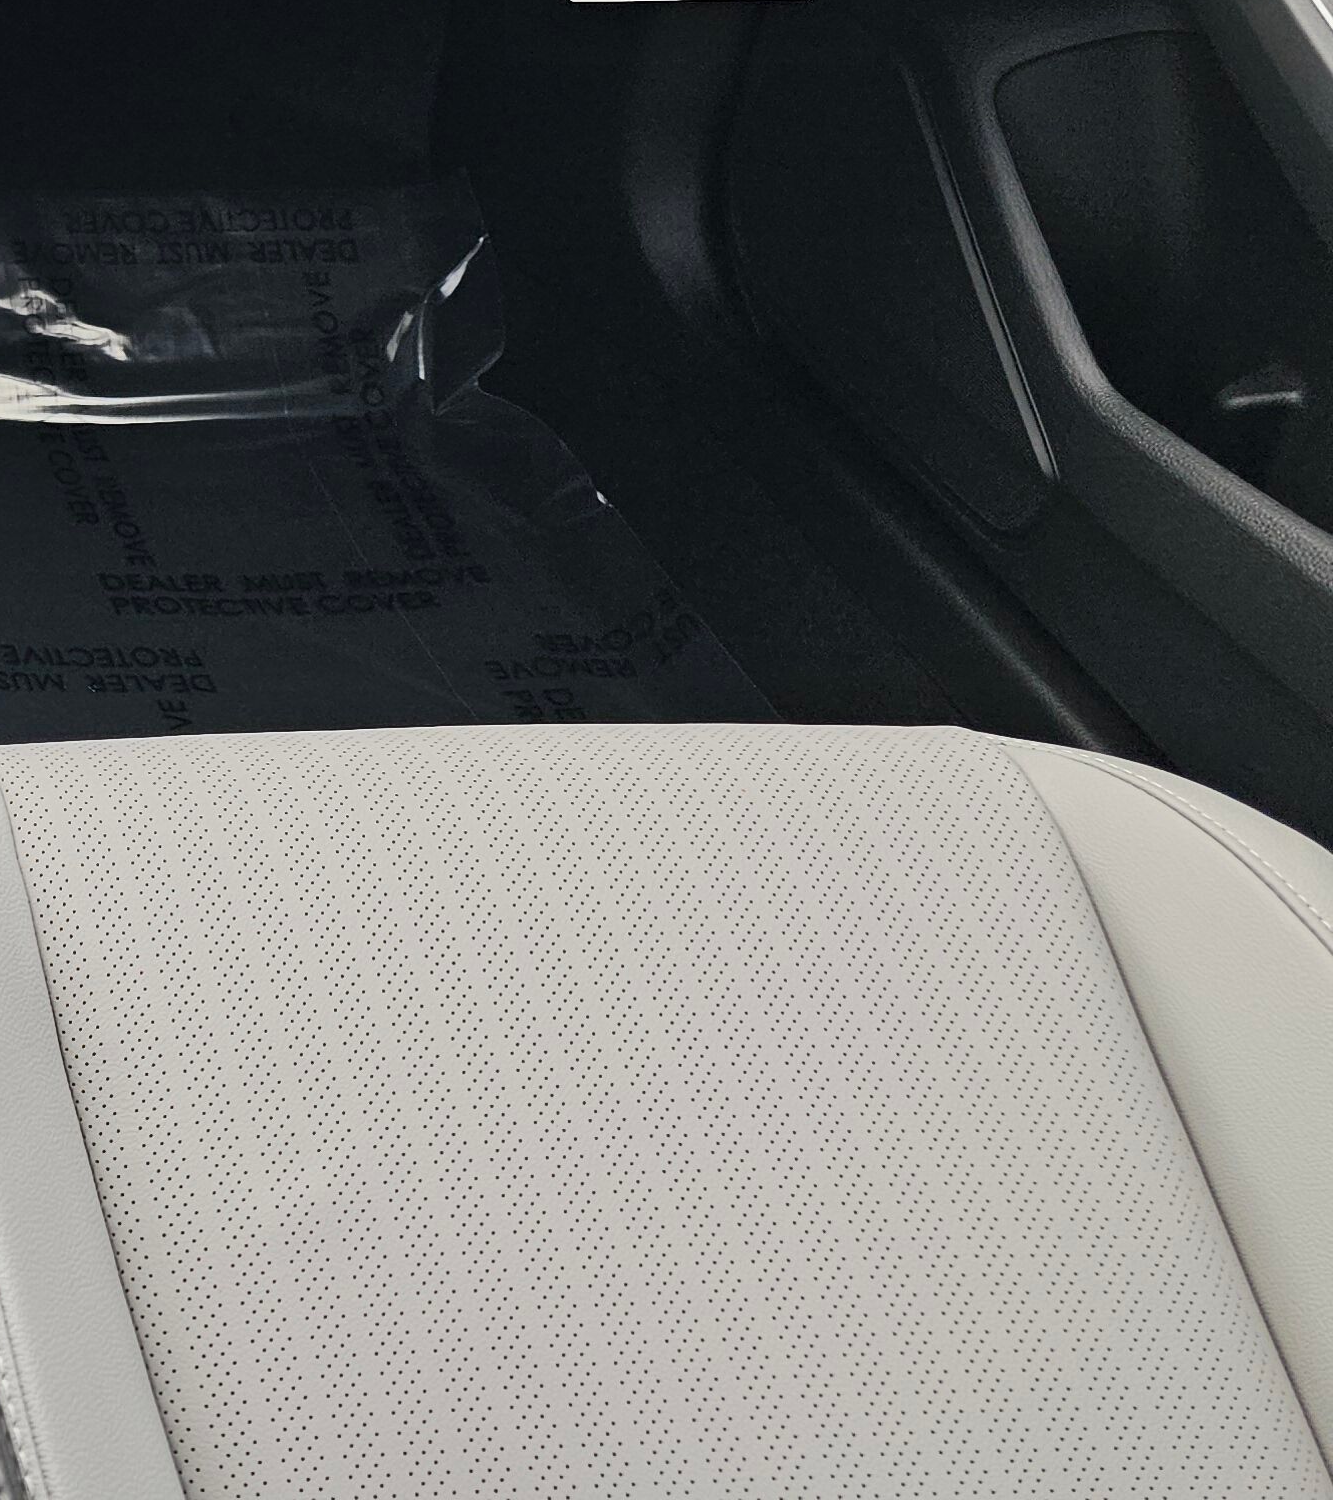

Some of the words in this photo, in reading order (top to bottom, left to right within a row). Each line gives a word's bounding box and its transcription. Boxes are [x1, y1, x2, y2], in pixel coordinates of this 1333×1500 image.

[97, 571, 225, 593] DEALER
[238, 569, 326, 593] MUST
[342, 564, 491, 590] REMOVE
[110, 594, 311, 617] PROTECTIVE
[319, 590, 441, 614] COVER
[1, 643, 204, 669] PROTECTIVE
[85, 672, 218, 694] DEALER
